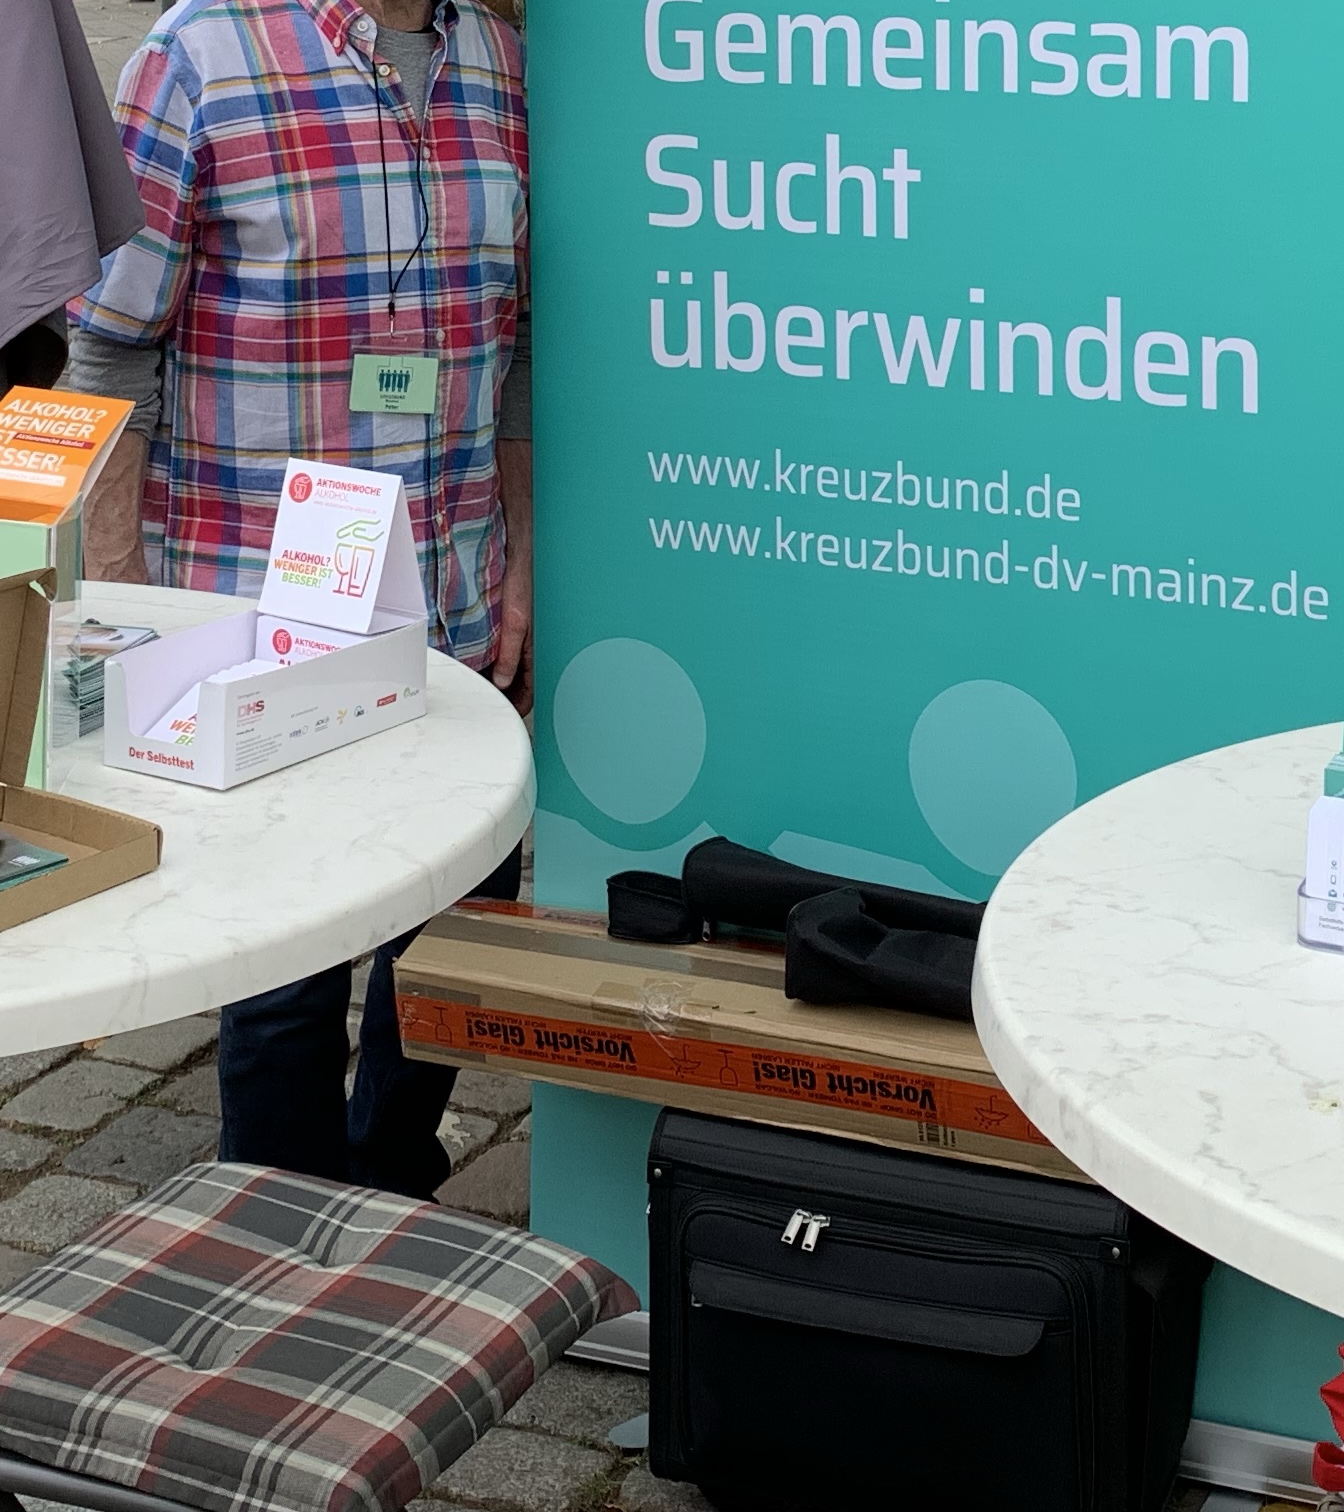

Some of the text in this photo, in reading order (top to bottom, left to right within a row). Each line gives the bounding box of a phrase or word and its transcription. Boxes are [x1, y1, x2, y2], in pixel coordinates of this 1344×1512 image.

[645, 134, 921, 239] Sucht
[650, 270, 1259, 414] überwinden
[3, 399, 108, 423] ALKOHOL?
[314, 490, 349, 502] ALKOHOL
[316, 478, 382, 496] AKTIONSWOCHE
[647, 448, 1081, 523] www.kreuzbund.de
[274, 559, 333, 579] WENIGER IST
[282, 550, 330, 566] ALKOHOL?
[649, 515, 1330, 622] www.kreuzbund-dv-mainz.de
[282, 573, 321, 588] BESSER!
[238, 700, 265, 718] DHS
[129, 747, 194, 770] Der Selbsttest
[467, 1018, 637, 1064] Vorsicht Glas!
[753, 1060, 937, 1112] Vorsicht Glas!
